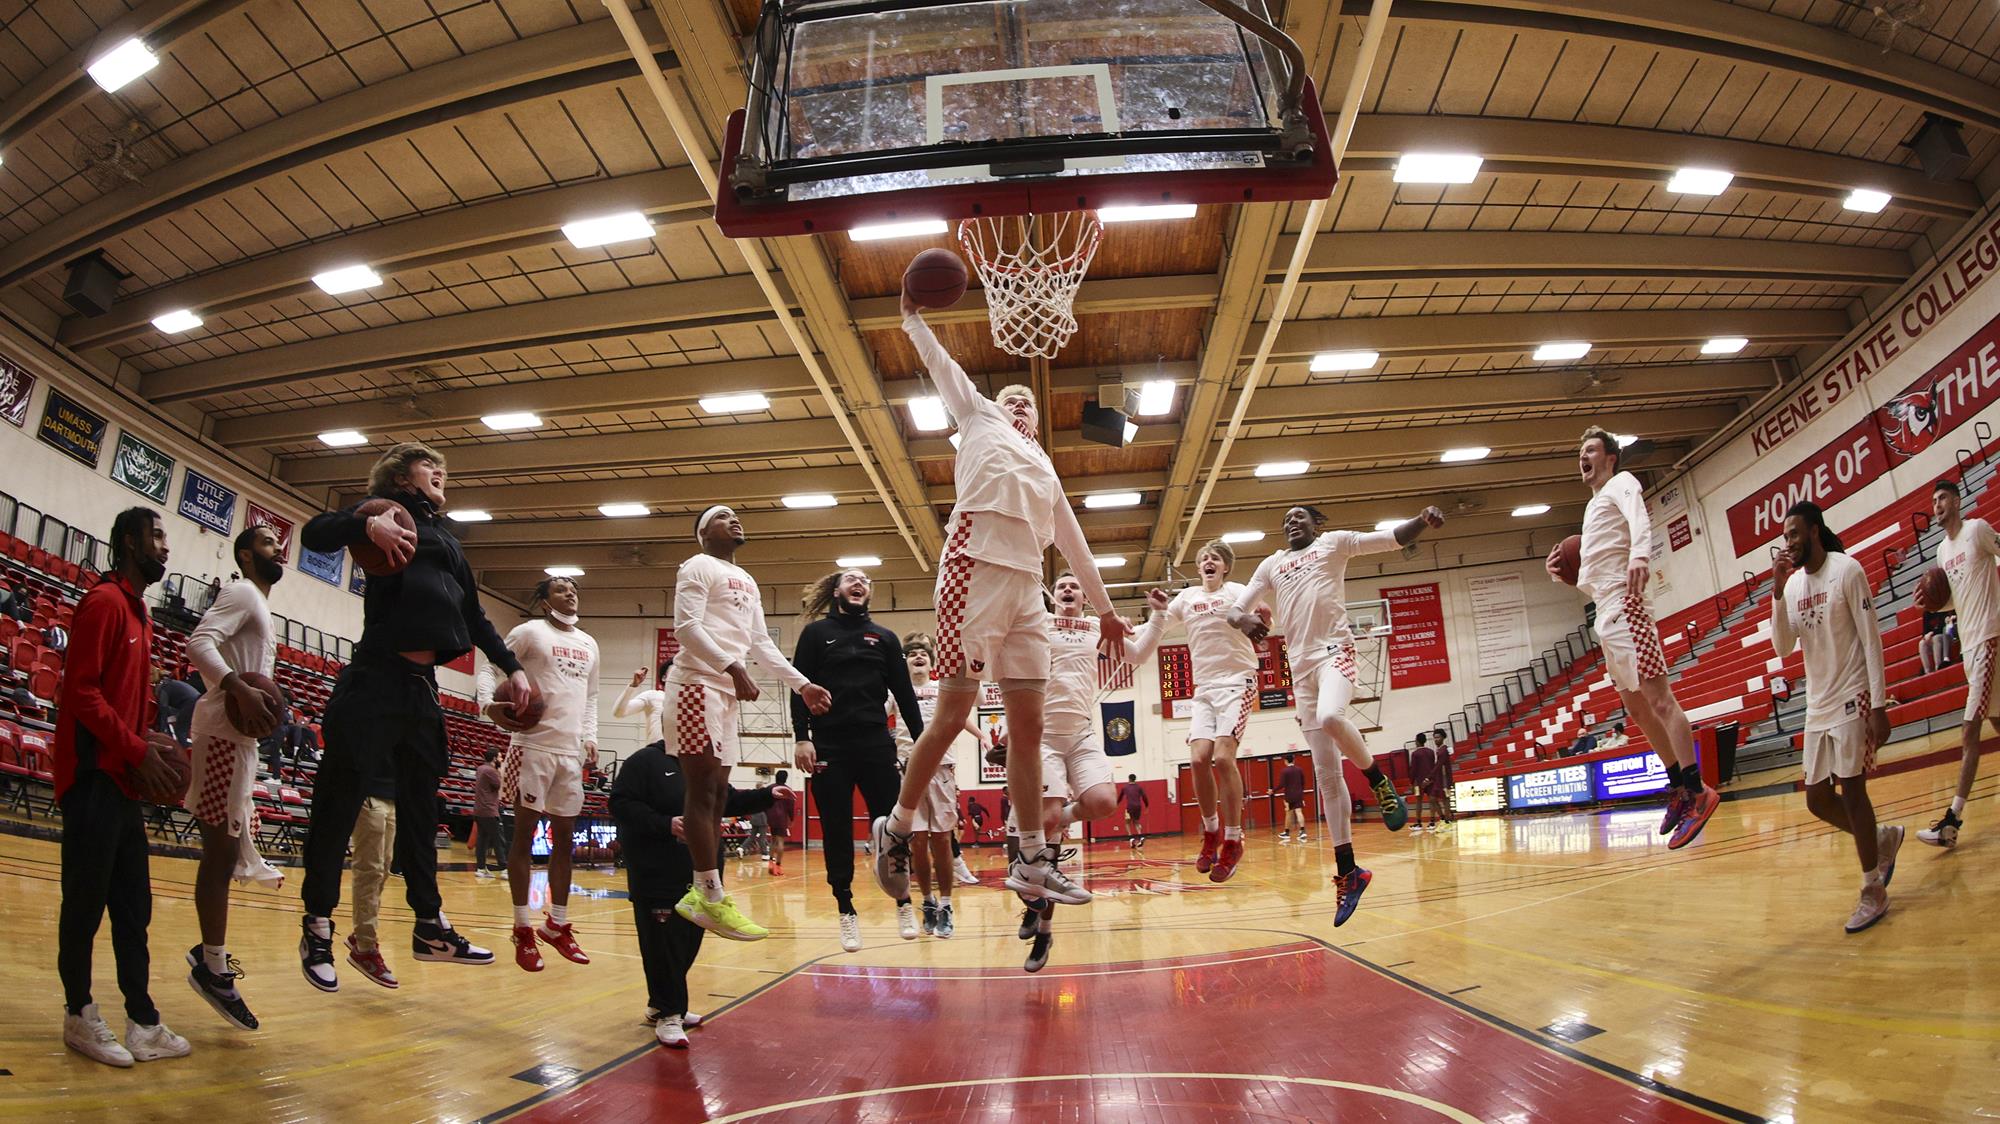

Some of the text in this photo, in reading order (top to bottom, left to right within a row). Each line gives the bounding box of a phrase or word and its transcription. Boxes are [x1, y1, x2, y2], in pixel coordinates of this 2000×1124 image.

[1751, 386, 1822, 457] KEENE
[1823, 322, 1900, 404] STATE
[1935, 341, 2000, 416] THE
[58, 406, 93, 434] UMASS
[44, 416, 98, 454] DARTMOUTH
[120, 443, 168, 476] PLYMOUTH
[127, 467, 156, 487] STATE
[196, 479, 225, 501] LITTLE
[1754, 463, 1833, 536] HOME
[1834, 435, 1871, 484] OF
[182, 500, 229, 530] CONFERENCE
[196, 493, 220, 511] EAST
[1558, 765, 1587, 783] TEES
[1602, 756, 1644, 775] FENTON
[1525, 781, 1587, 797] SCREEN PRINTING
